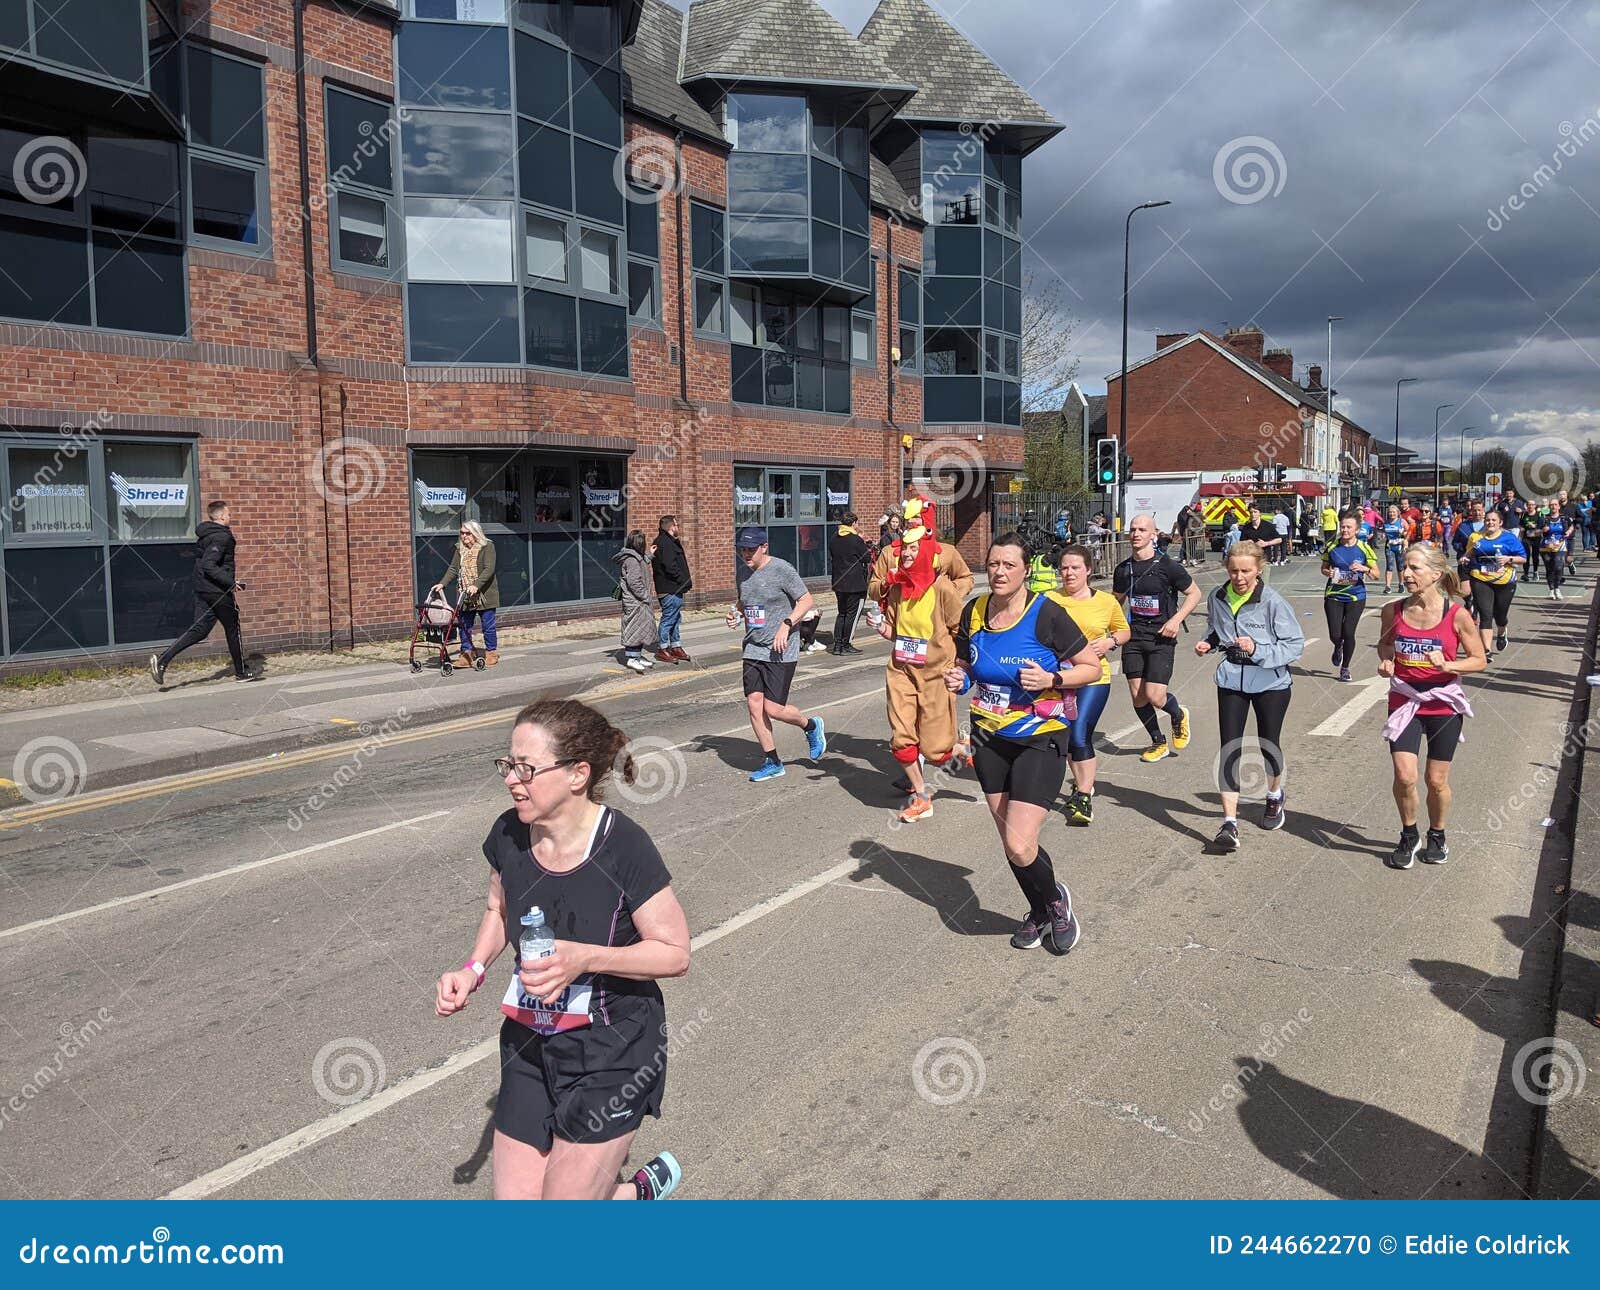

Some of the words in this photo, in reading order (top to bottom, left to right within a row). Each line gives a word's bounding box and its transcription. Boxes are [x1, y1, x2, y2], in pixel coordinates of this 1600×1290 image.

[127, 488, 185, 500] Shred-it
[426, 491, 465, 501] Shred-it
[589, 492, 618, 501] Shred-it
[902, 641, 919, 653] 5652
[532, 1011, 554, 1026] JANE
